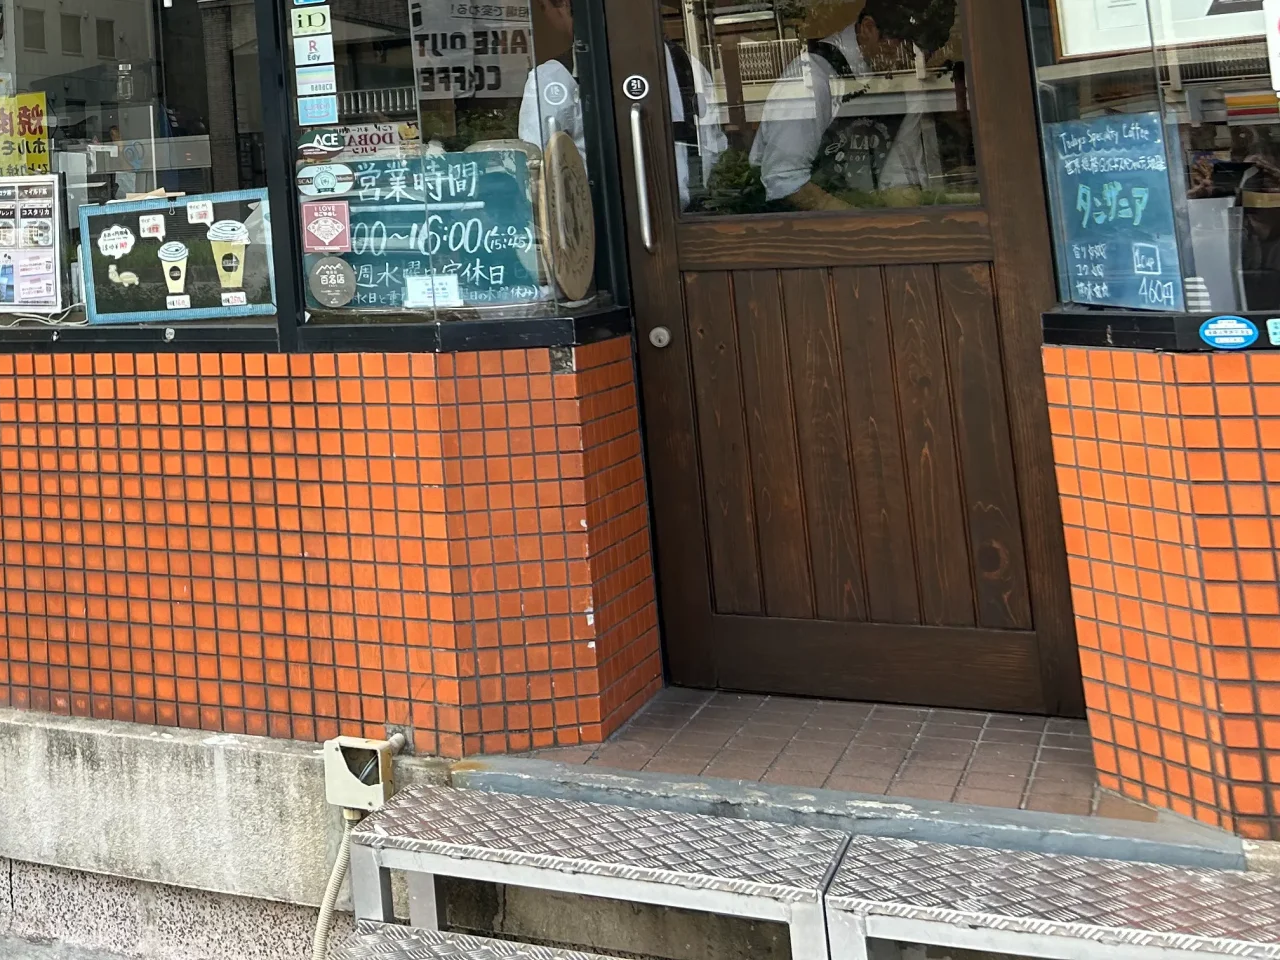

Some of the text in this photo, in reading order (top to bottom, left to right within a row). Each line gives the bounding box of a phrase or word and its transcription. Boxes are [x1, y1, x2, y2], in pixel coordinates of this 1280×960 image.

[297, 11, 326, 28] iD
[307, 53, 321, 61] Edy
[313, 133, 339, 146] ACE
[356, 160, 479, 202] 営業時間
[22, 208, 50, 216] コスタリカ
[320, 273, 345, 285] 百名店
[1138, 276, 1175, 307] 460円
